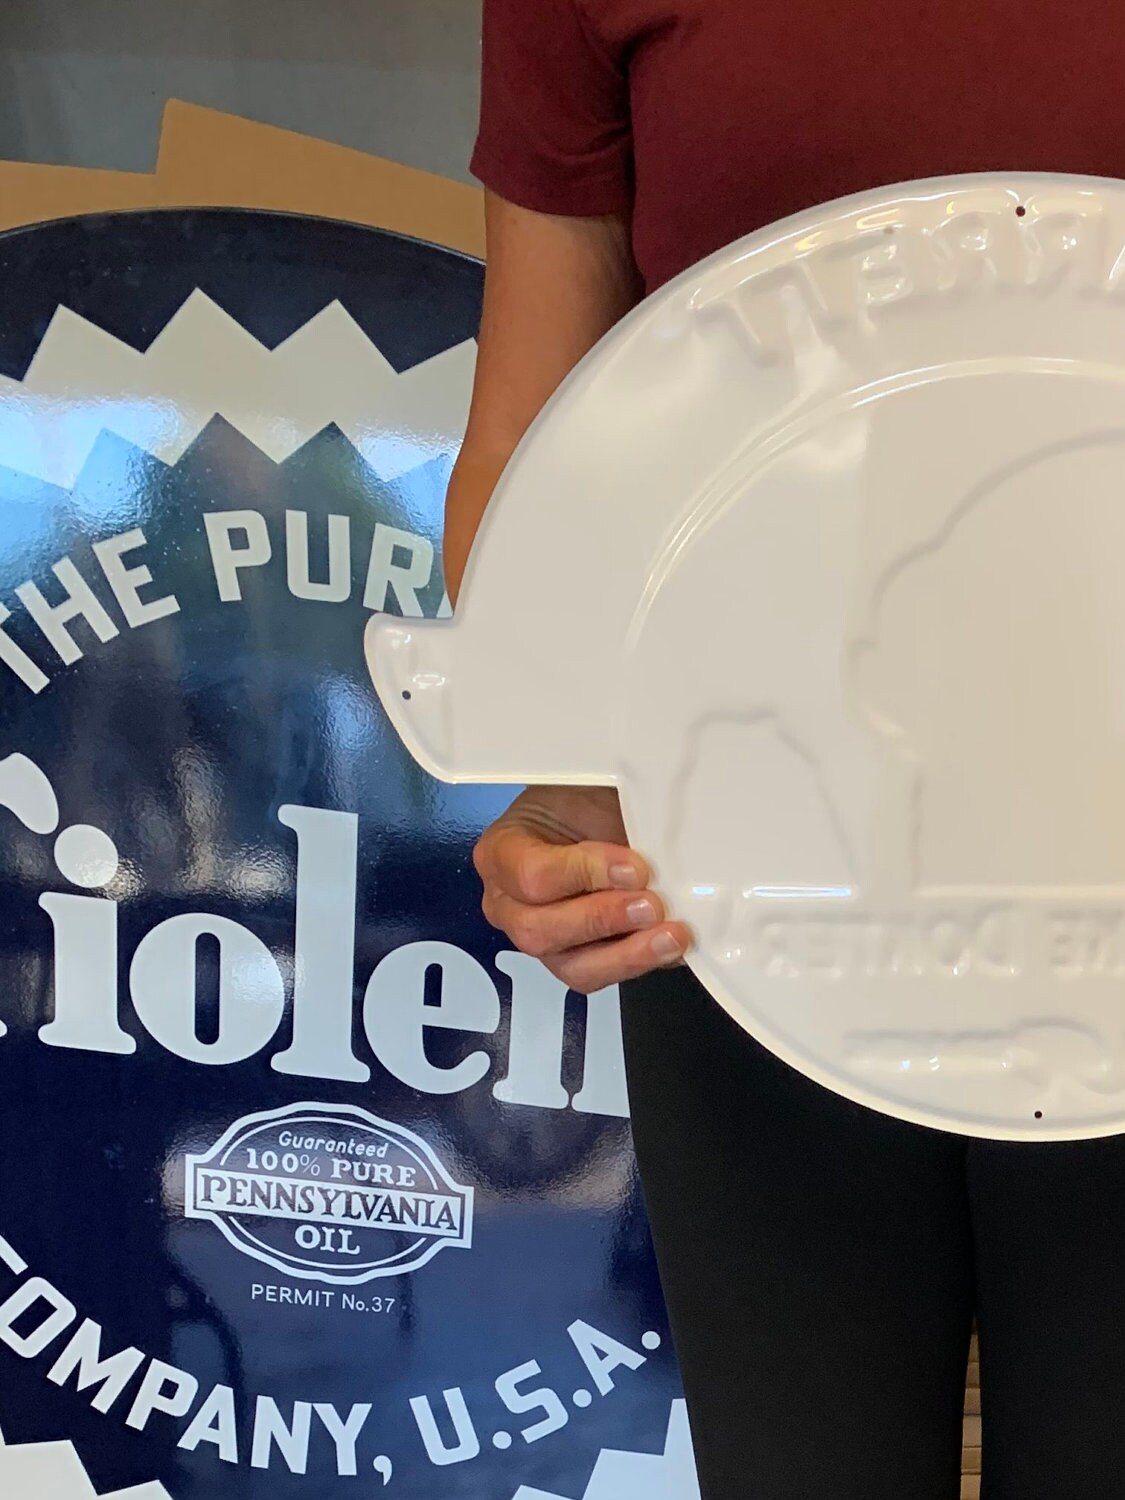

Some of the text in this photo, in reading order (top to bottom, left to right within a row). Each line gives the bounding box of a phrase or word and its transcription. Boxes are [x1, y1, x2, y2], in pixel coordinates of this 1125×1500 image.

[203, 509, 454, 618] PUR
[0, 752, 631, 1118] iolen
[246, 1148, 417, 1188] 100% PURE
[278, 1130, 389, 1158] Guaranteed
[200, 1173, 458, 1231] PENNSYLVANIA
[294, 1225, 361, 1255] OIL
[251, 1284, 396, 1313] PERMIT No.37
[0, 1234, 661, 1486] OMPANY, U.S.A.
